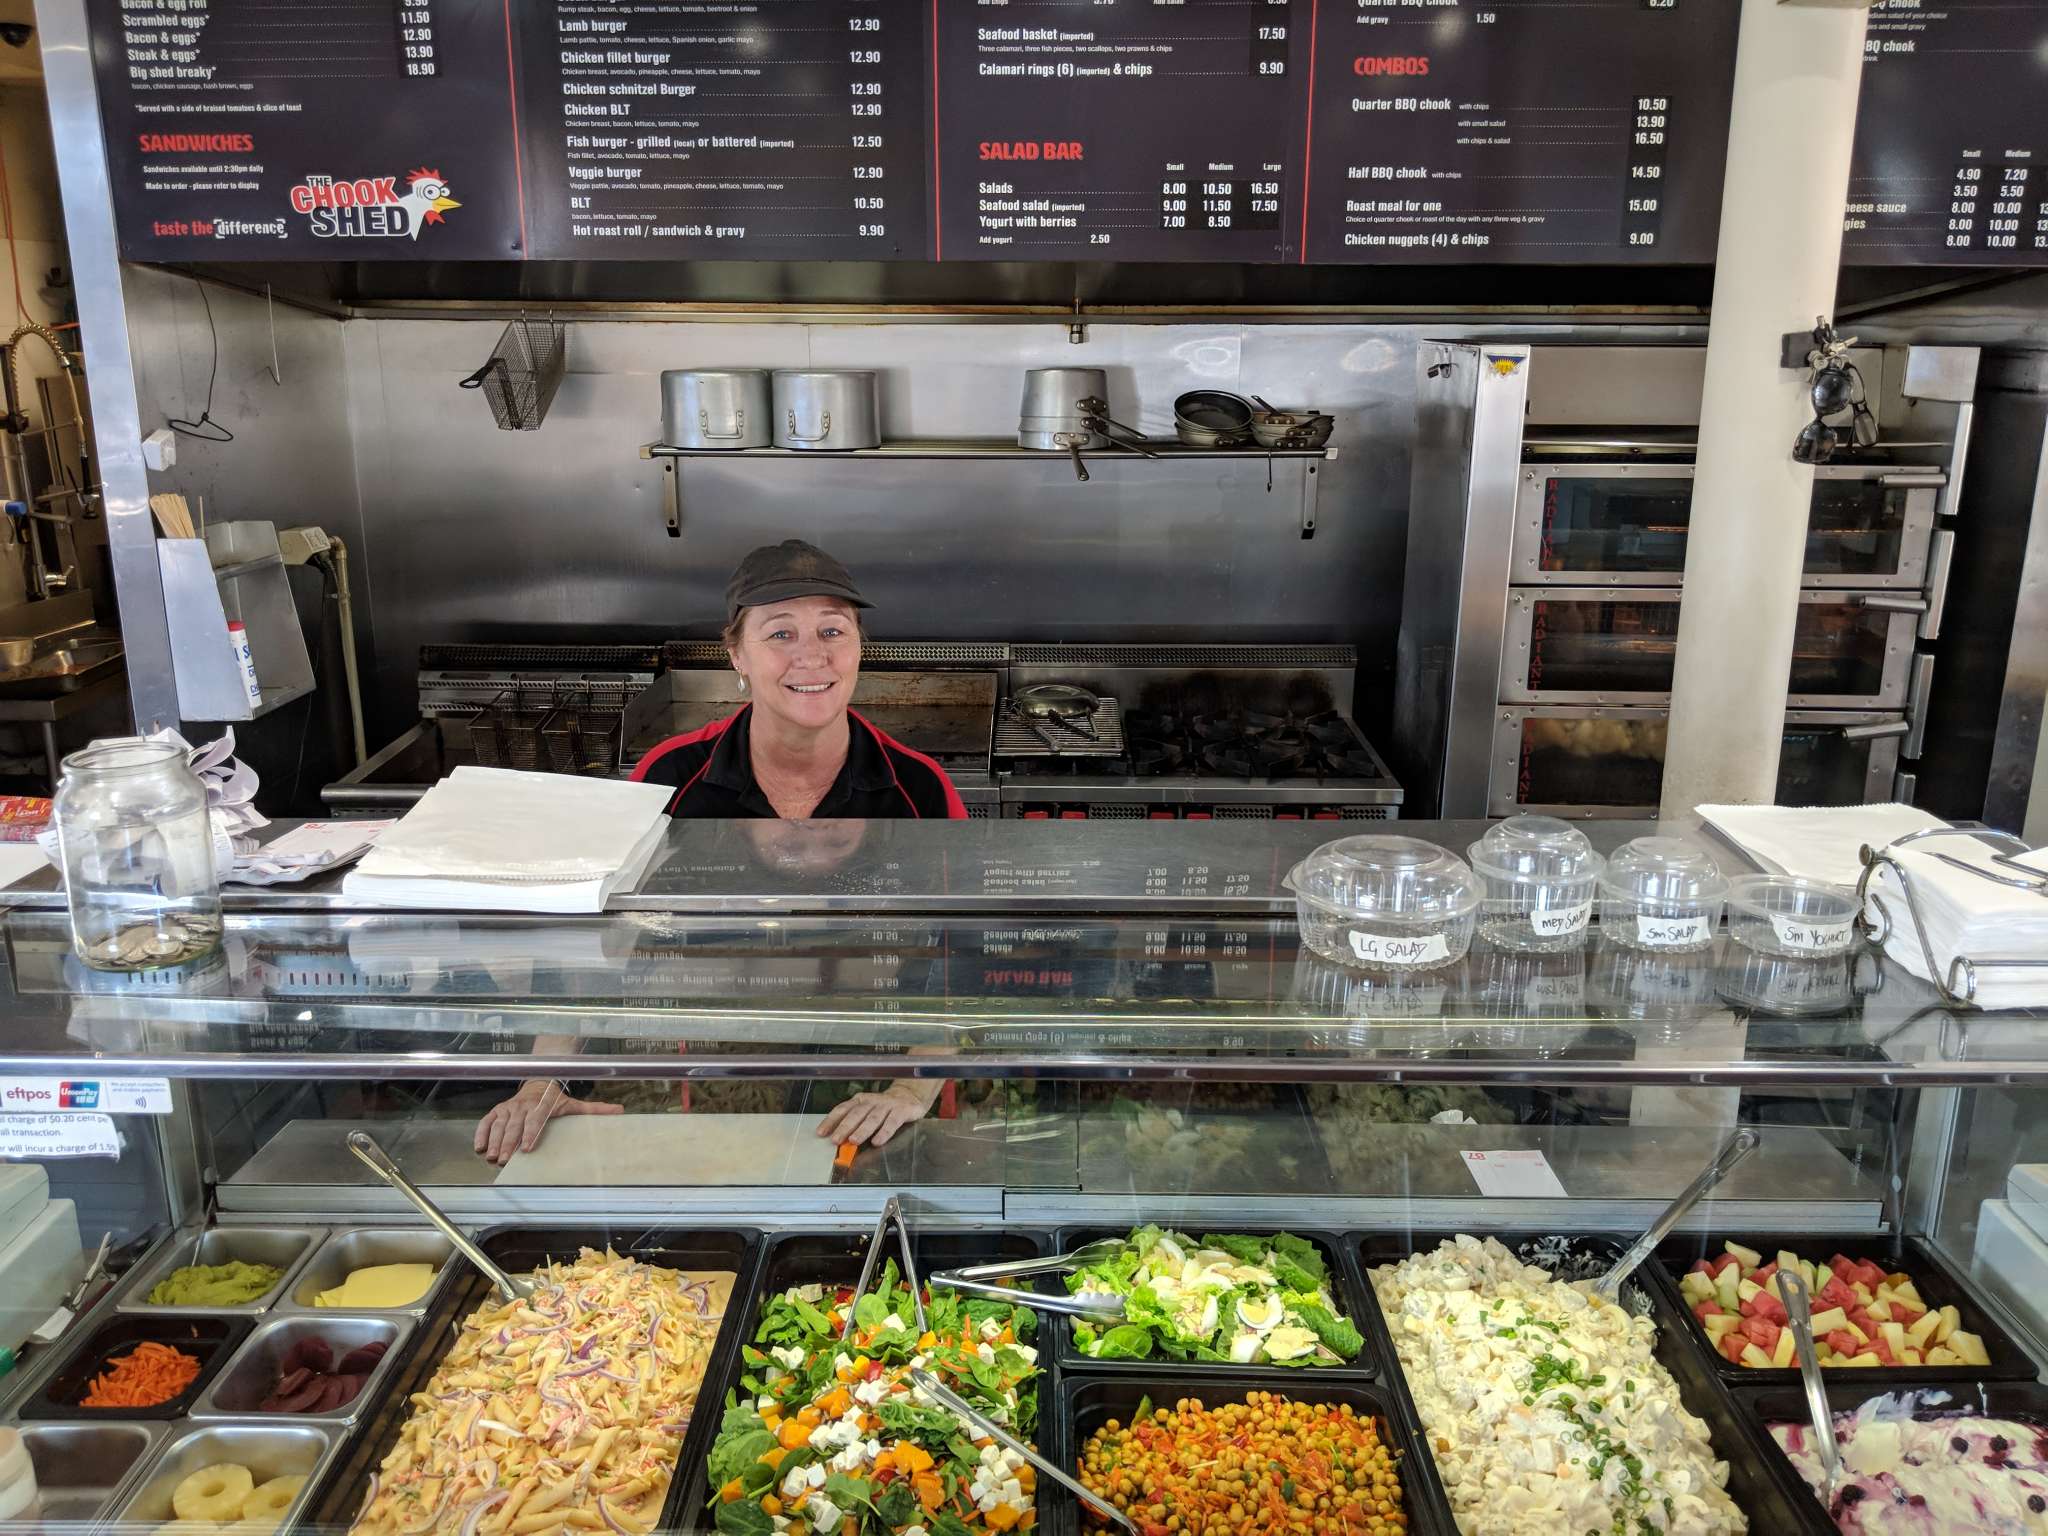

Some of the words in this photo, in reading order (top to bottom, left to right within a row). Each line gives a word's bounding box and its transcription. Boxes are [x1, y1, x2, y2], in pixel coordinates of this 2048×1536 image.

[123, 15, 178, 27] Scrambled
[402, 12, 429, 24] 11.50
[559, 20, 588, 32] Lamb
[592, 20, 627, 33] burger
[849, 19, 880, 31] 12.90
[126, 32, 157, 43] Bacon
[161, 32, 168, 43] &
[404, 29, 431, 41] 12.90
[978, 29, 1019, 40] Seafood
[1023, 29, 1057, 40] basket
[1060, 32, 1094, 41] (imported)
[1259, 28, 1285, 39] 17.50
[405, 46, 433, 58] 13.90
[1883, 40, 1915, 52] chook
[128, 50, 157, 61] Steak
[161, 50, 169, 61] &
[562, 52, 604, 63] Chicken
[607, 52, 632, 63] fillet
[635, 52, 670, 65] burger
[850, 51, 880, 63] 12.90
[407, 63, 434, 76] 18.90
[980, 64, 1024, 75] Calamari
[1028, 64, 1054, 77] rings
[1058, 63, 1074, 77] (6)
[1077, 68, 1110, 76] (imported)
[1113, 64, 1122, 75] &
[1125, 64, 1152, 77] chips
[1260, 62, 1283, 74] 9.90
[1354, 57, 1429, 75] COMBOS
[130, 67, 147, 80] Big
[150, 67, 174, 77] shed
[564, 84, 606, 95] Chicken
[609, 84, 657, 95] schnitzel
[661, 84, 696, 97] Burger
[851, 83, 881, 95] 12.90
[565, 104, 607, 115] Chicken
[611, 104, 630, 115] BLT
[852, 104, 881, 115] 12.90
[1352, 98, 1392, 112] Quarter
[1395, 98, 1416, 111] BBQ
[1420, 98, 1451, 110] chook
[1473, 103, 1489, 111] chips
[1638, 98, 1666, 111] 10.50
[1637, 116, 1665, 128] 13.90
[140, 134, 253, 152] SANDWICHES
[567, 136, 589, 147] Fish
[593, 136, 627, 149] burger
[637, 136, 670, 149] grilled
[674, 140, 695, 149] (local)
[698, 139, 709, 147] or
[712, 136, 756, 147] battered
[760, 140, 794, 149] (imported)
[852, 136, 881, 147] 12.50
[1635, 132, 1663, 145] 16.50
[979, 142, 1039, 160] SALAD
[1044, 143, 1083, 160] BAR
[569, 167, 604, 180] Veggie
[607, 167, 642, 180] burger
[853, 167, 883, 178] 12.90
[1166, 163, 1184, 171] Small
[1209, 163, 1234, 171] Medium
[1263, 163, 1281, 172] Large
[1348, 167, 1368, 178] Half
[1372, 167, 1393, 180] BBQ
[1396, 167, 1427, 178] chook
[1631, 167, 1659, 178] 14.50
[1956, 169, 1981, 180] 4.90
[2005, 169, 2027, 180] 7.20
[307, 176, 332, 188] THE
[979, 183, 1013, 193] Salads
[1163, 183, 1186, 195] 8.00
[1203, 183, 1232, 195] 10.50
[1251, 183, 1278, 194] 16.50
[1954, 186, 1977, 197] 3.50
[2000, 186, 2024, 197] 5.50
[290, 178, 400, 214] CHOOK
[571, 198, 591, 208] BLT
[854, 197, 883, 209] 10.50
[979, 200, 1019, 211] Seafood
[1023, 200, 1049, 211] salad
[1052, 203, 1084, 212] (imported)
[1163, 200, 1186, 212] 9.00
[1203, 200, 1231, 212] 11.50
[1252, 200, 1277, 211] 17.50
[1347, 201, 1375, 212] Roast
[1378, 201, 1402, 212] meal
[1405, 201, 1420, 212] for
[1423, 203, 1441, 212] one
[1628, 200, 1657, 211] 15.00
[1876, 204, 1906, 213] sauce
[1952, 202, 1975, 214] 8.00
[1993, 203, 2021, 214] 10.00
[310, 206, 412, 237] SHED
[979, 217, 1013, 229] Yogurt
[1016, 217, 1038, 227] with
[1040, 217, 1076, 227] berries
[1163, 216, 1185, 227] 7.00
[1208, 216, 1231, 227] 8.50
[1949, 219, 1972, 230] 8.00
[1989, 219, 2018, 231] 10.00
[154, 222, 188, 237] taste
[192, 220, 213, 235] the
[217, 220, 285, 235] difference
[573, 225, 590, 236] Hot
[594, 225, 620, 236] roast
[624, 225, 641, 236] roll
[653, 225, 701, 236] sandwich
[705, 225, 713, 236] &
[716, 227, 745, 238] gravy
[859, 225, 884, 236] 9.90
[992, 237, 1012, 245] yogurt
[1090, 234, 1110, 243] 2.50
[1345, 234, 1385, 245] Chicken
[1388, 235, 1429, 247] nuggets
[1432, 234, 1447, 246] (4)
[1451, 234, 1459, 245] &
[1462, 234, 1489, 247] chips
[1630, 234, 1653, 245] 9.00
[1946, 235, 1970, 247] 8.00
[1987, 236, 2016, 247] 10.00
[7, 1087, 51, 1101] eftpos
[7, 1116, 36, 1124] charge
[38, 1115, 47, 1123] of
[56, 1144, 85, 1153] charge
[88, 1143, 97, 1151] of
